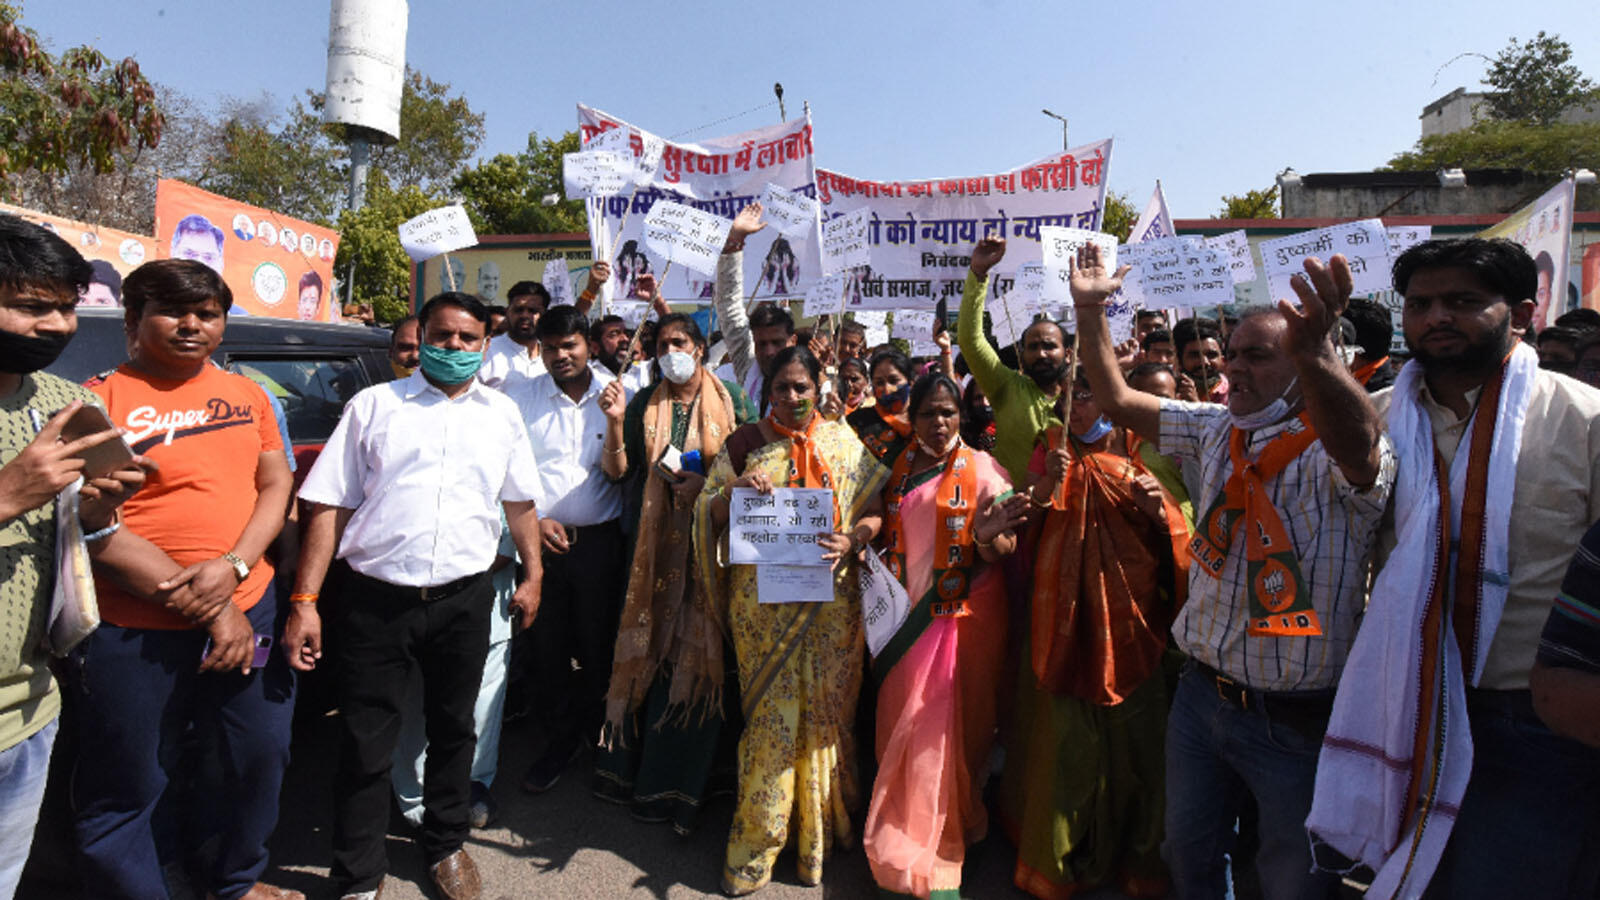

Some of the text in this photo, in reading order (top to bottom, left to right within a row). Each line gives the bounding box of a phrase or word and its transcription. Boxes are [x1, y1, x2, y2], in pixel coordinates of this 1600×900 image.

[734, 140, 755, 171] में
[1080, 149, 1104, 186] दो
[885, 211, 917, 245] को
[921, 218, 977, 245] न्याय
[1345, 227, 1371, 246] को
[887, 279, 937, 300] समाज,
[940, 279, 966, 297] जय
[992, 273, 1015, 299] (रा
